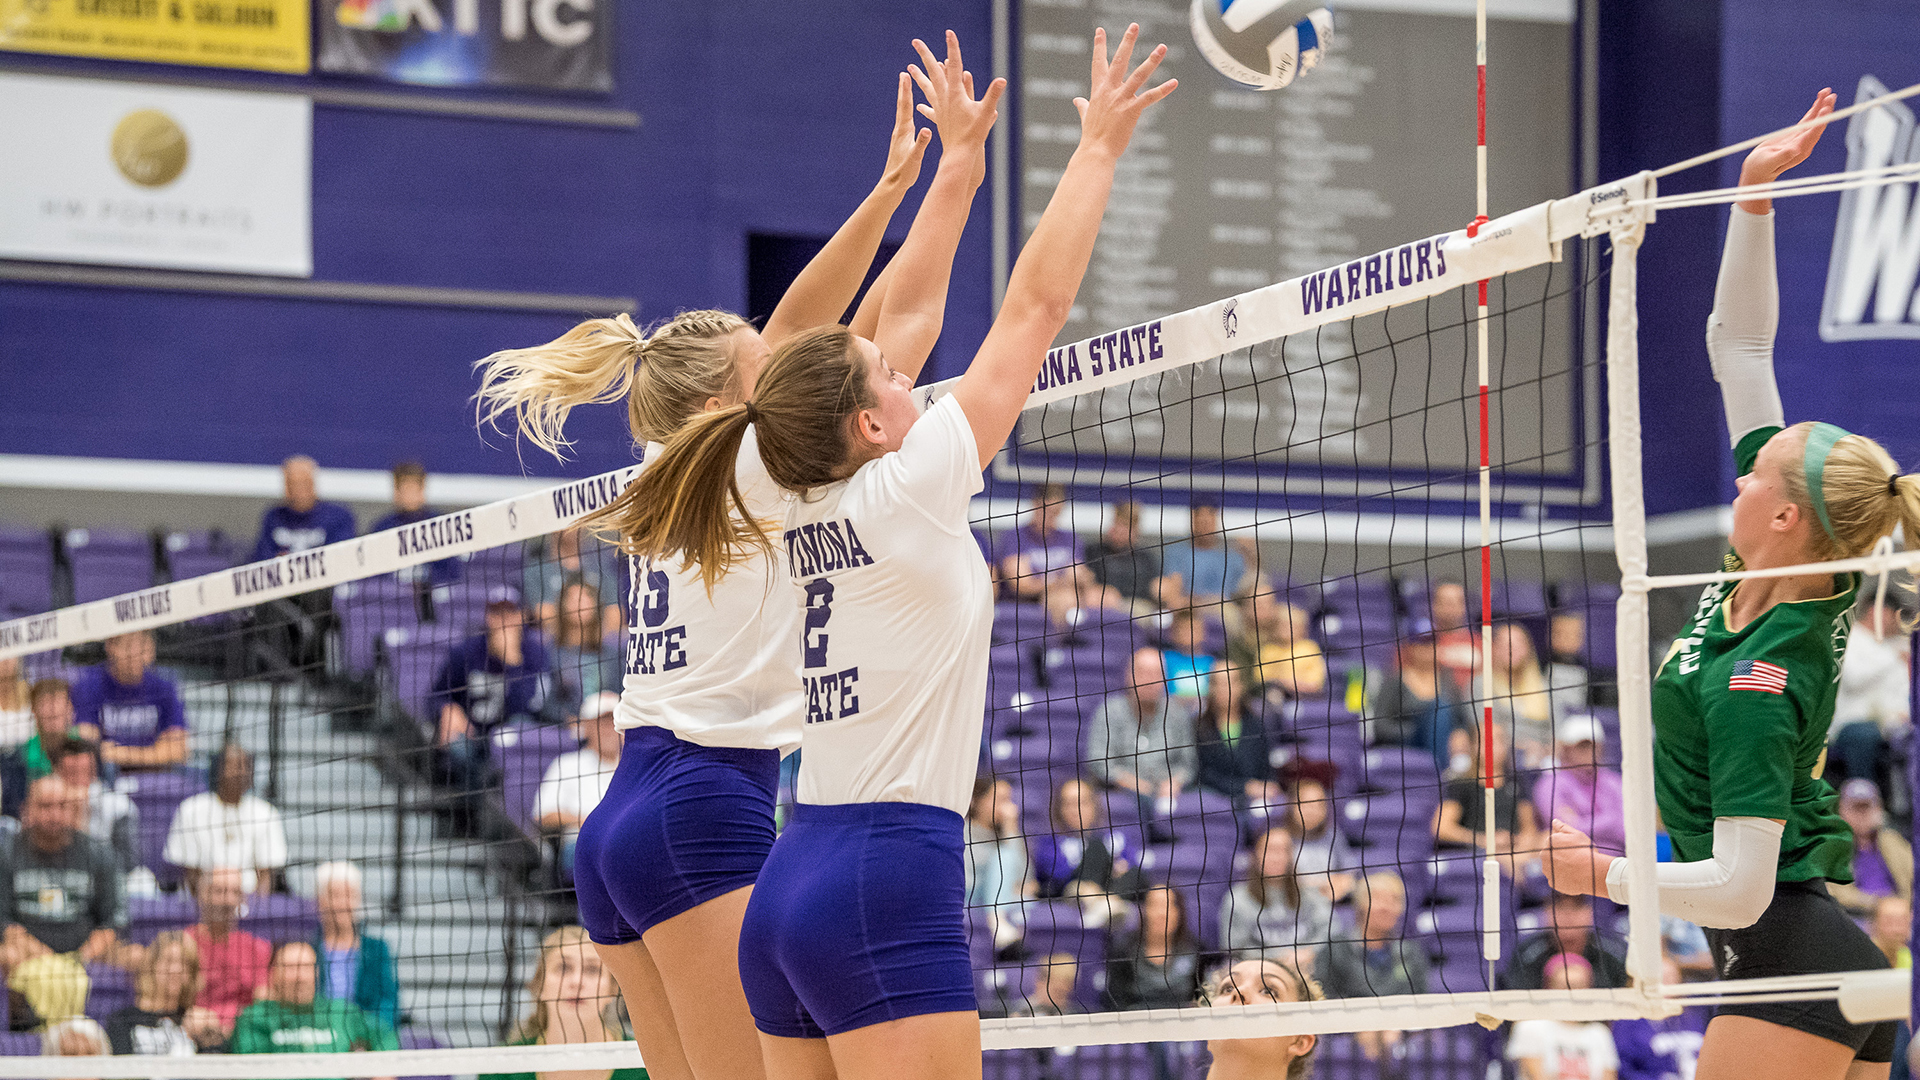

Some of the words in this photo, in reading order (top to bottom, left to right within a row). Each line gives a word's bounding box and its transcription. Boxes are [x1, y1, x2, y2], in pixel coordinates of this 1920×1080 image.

[1301, 235, 1450, 316] WARRIORS
[1030, 345, 1083, 394] ONA
[1089, 320, 1164, 377] STATE
[552, 474, 619, 519] WINONA
[398, 512, 473, 556] WARRIORS
[626, 625, 687, 675] TATE
[803, 577, 835, 668] 2
[802, 667, 860, 725] ATE
